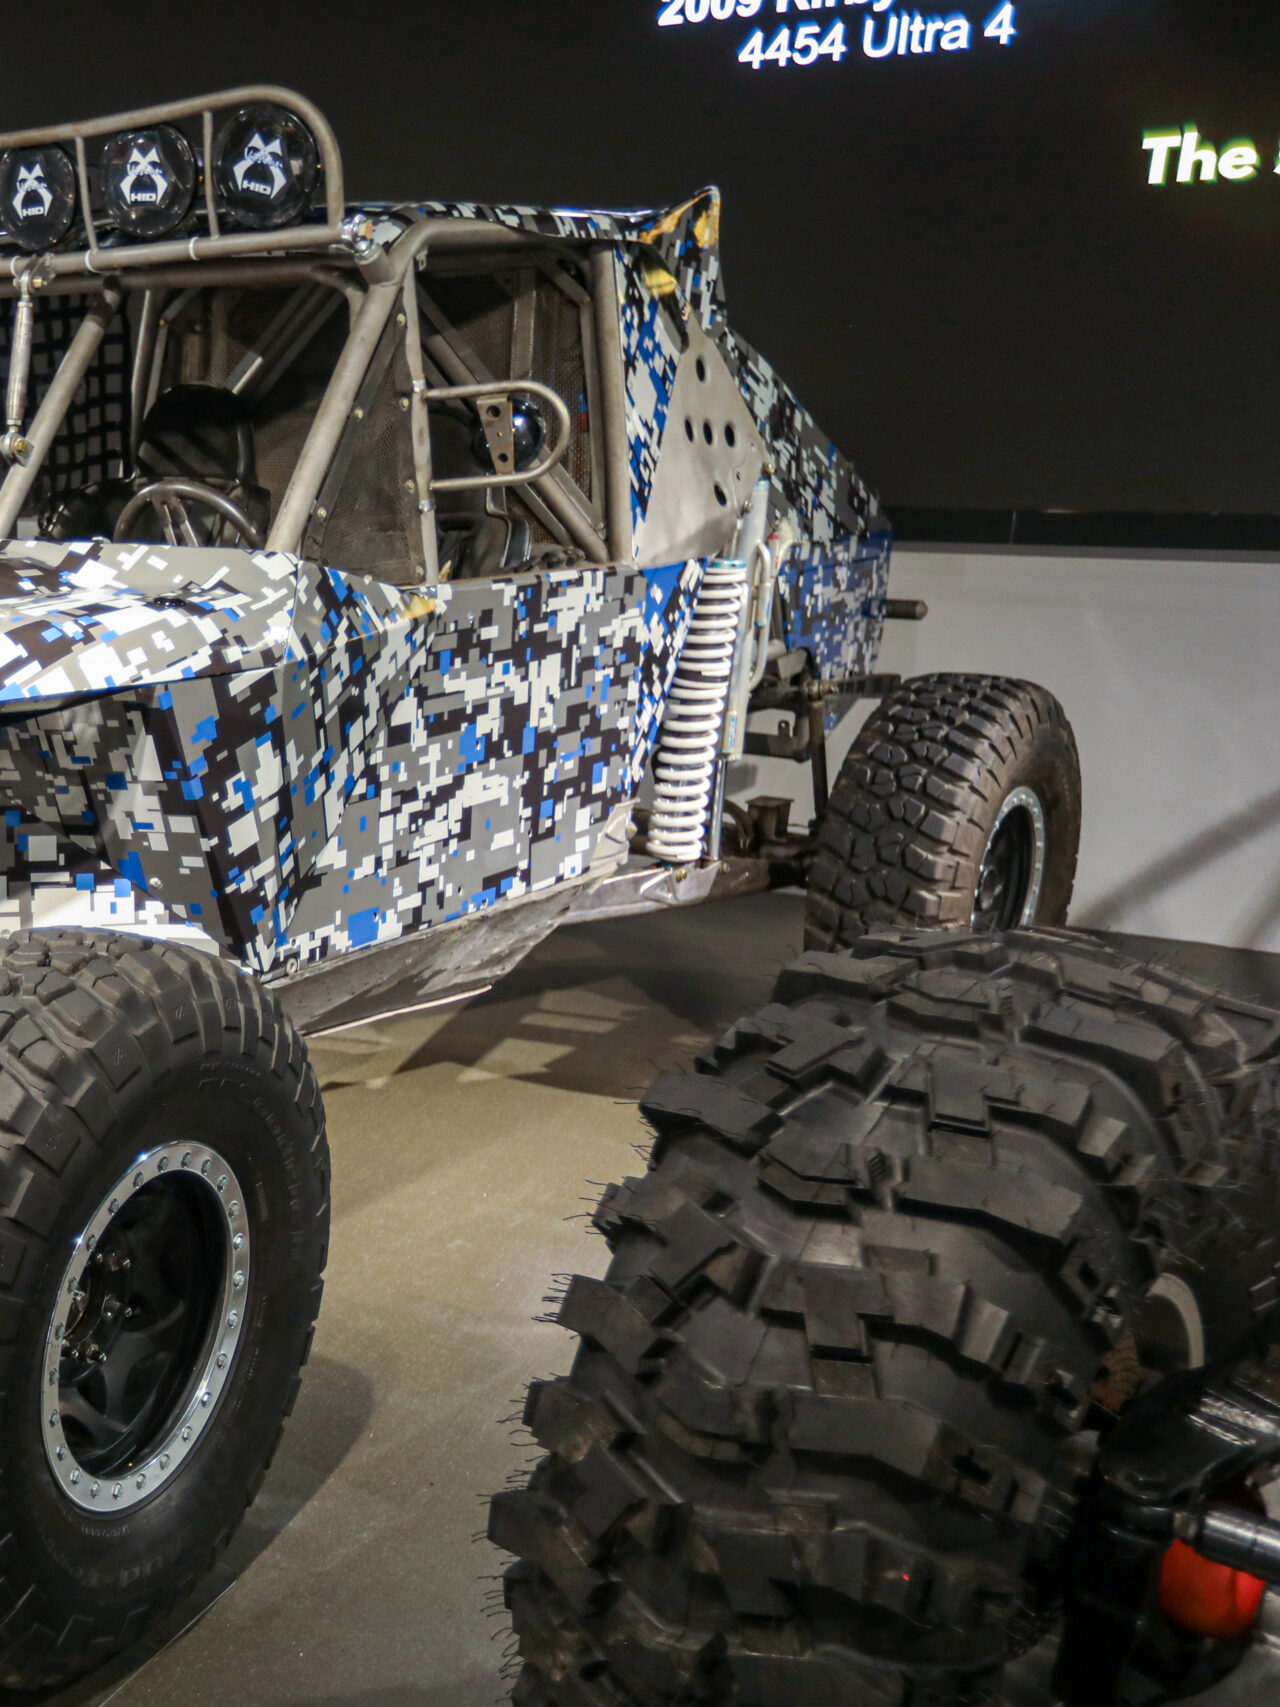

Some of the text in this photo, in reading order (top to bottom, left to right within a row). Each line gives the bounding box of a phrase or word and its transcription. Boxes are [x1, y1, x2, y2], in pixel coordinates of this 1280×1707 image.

[737, 1, 1015, 70] 4454 Ultra 4
[1142, 124, 1259, 185] The
[242, 179, 272, 196] HID
[130, 193, 156, 202] HID
[22, 206, 44, 217] HID
